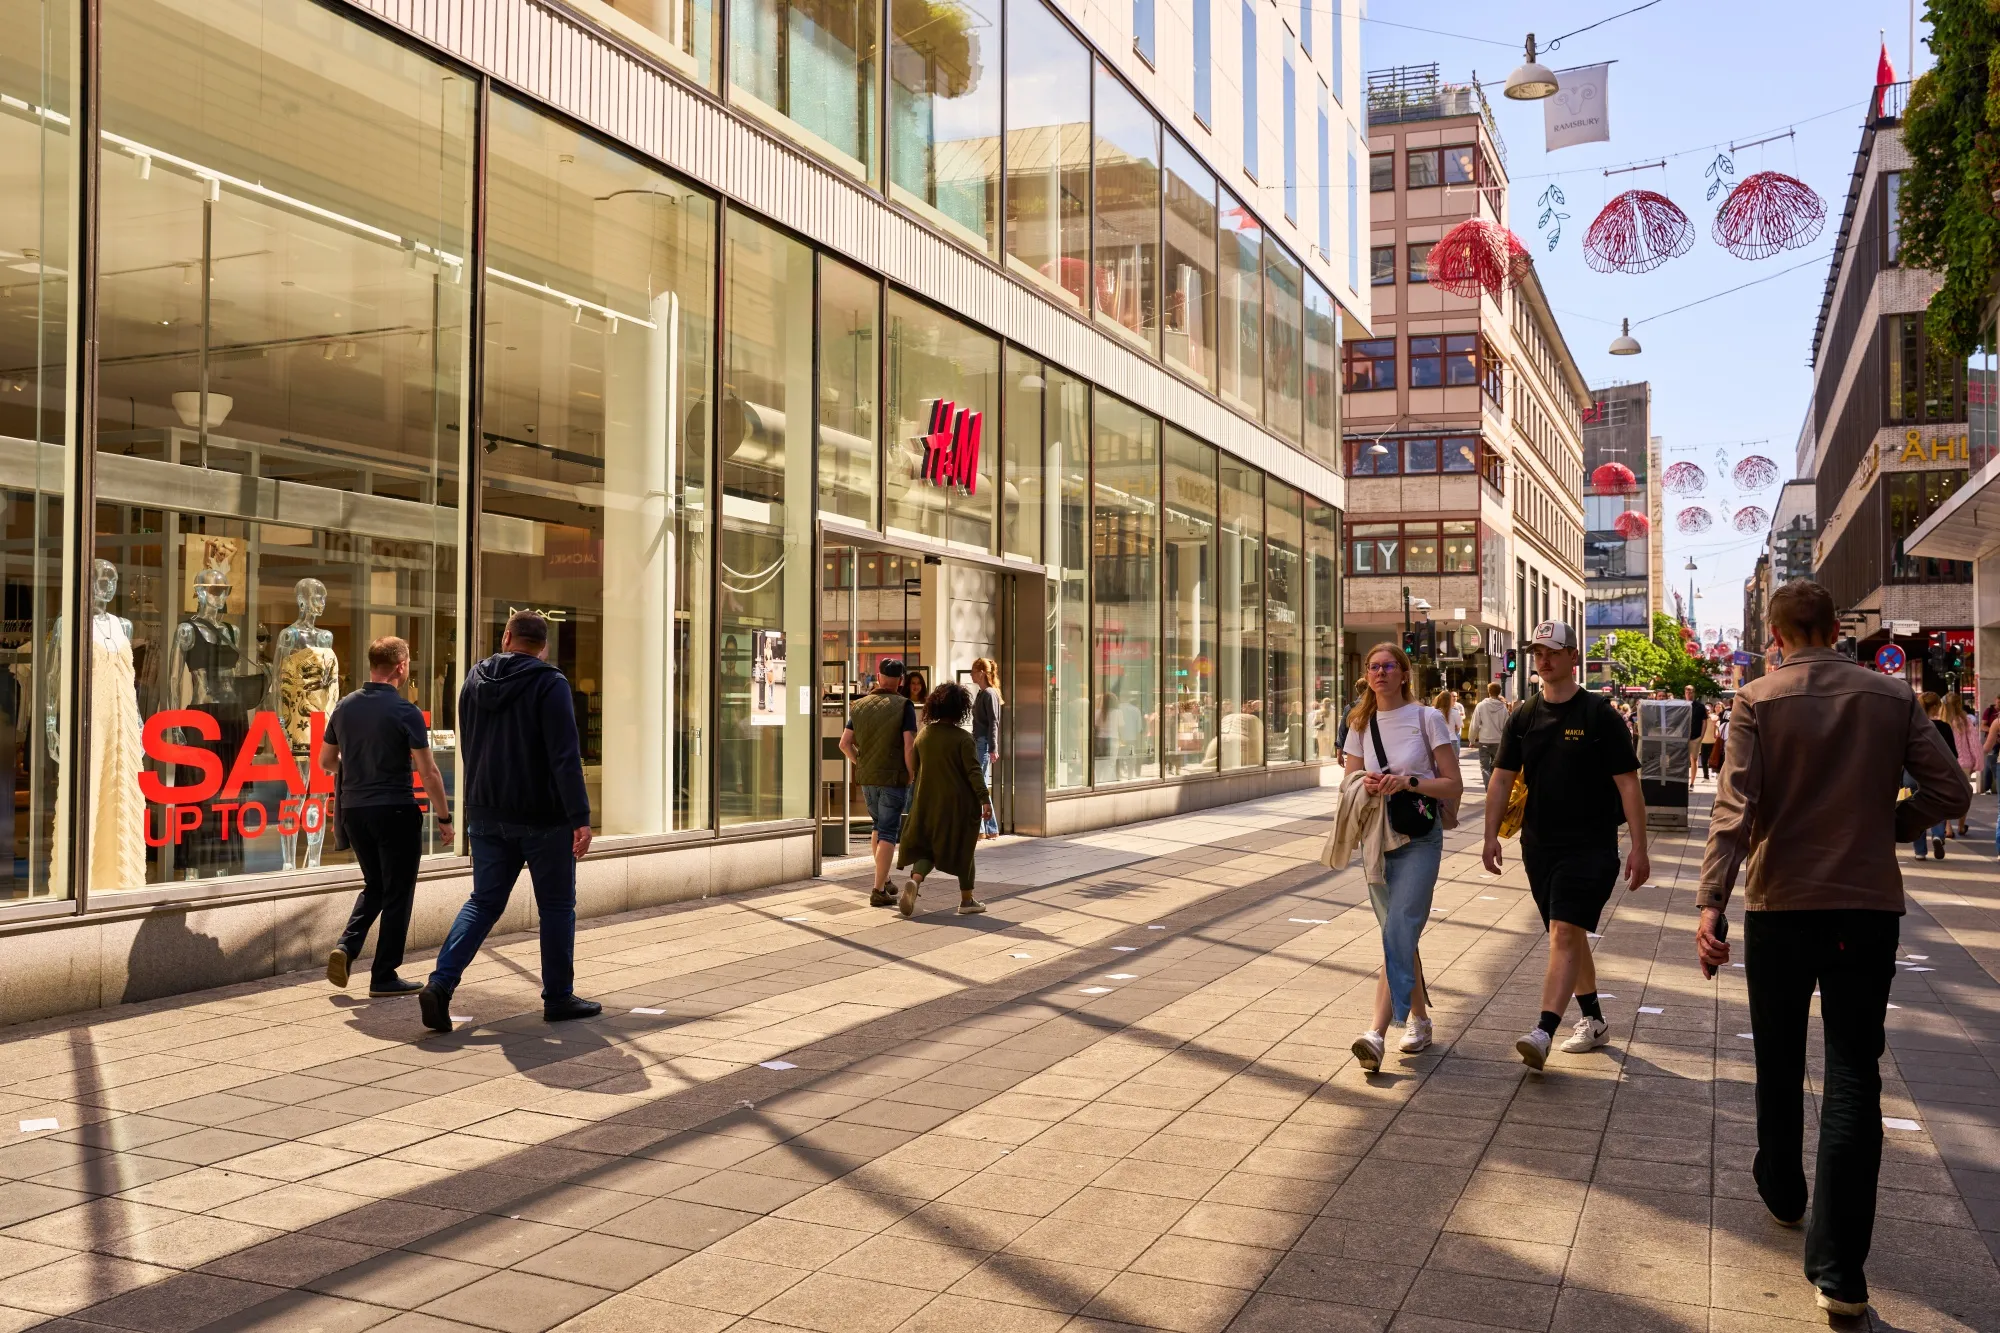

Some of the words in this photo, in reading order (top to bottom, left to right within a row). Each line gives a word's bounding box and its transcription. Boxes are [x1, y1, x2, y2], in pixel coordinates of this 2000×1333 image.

[1553, 117, 1600, 132] RAMSBURY
[920, 397, 983, 496] H&M
[137, 709, 431, 805] SAL
[143, 805, 203, 847] UP
[212, 801, 268, 841] TO
